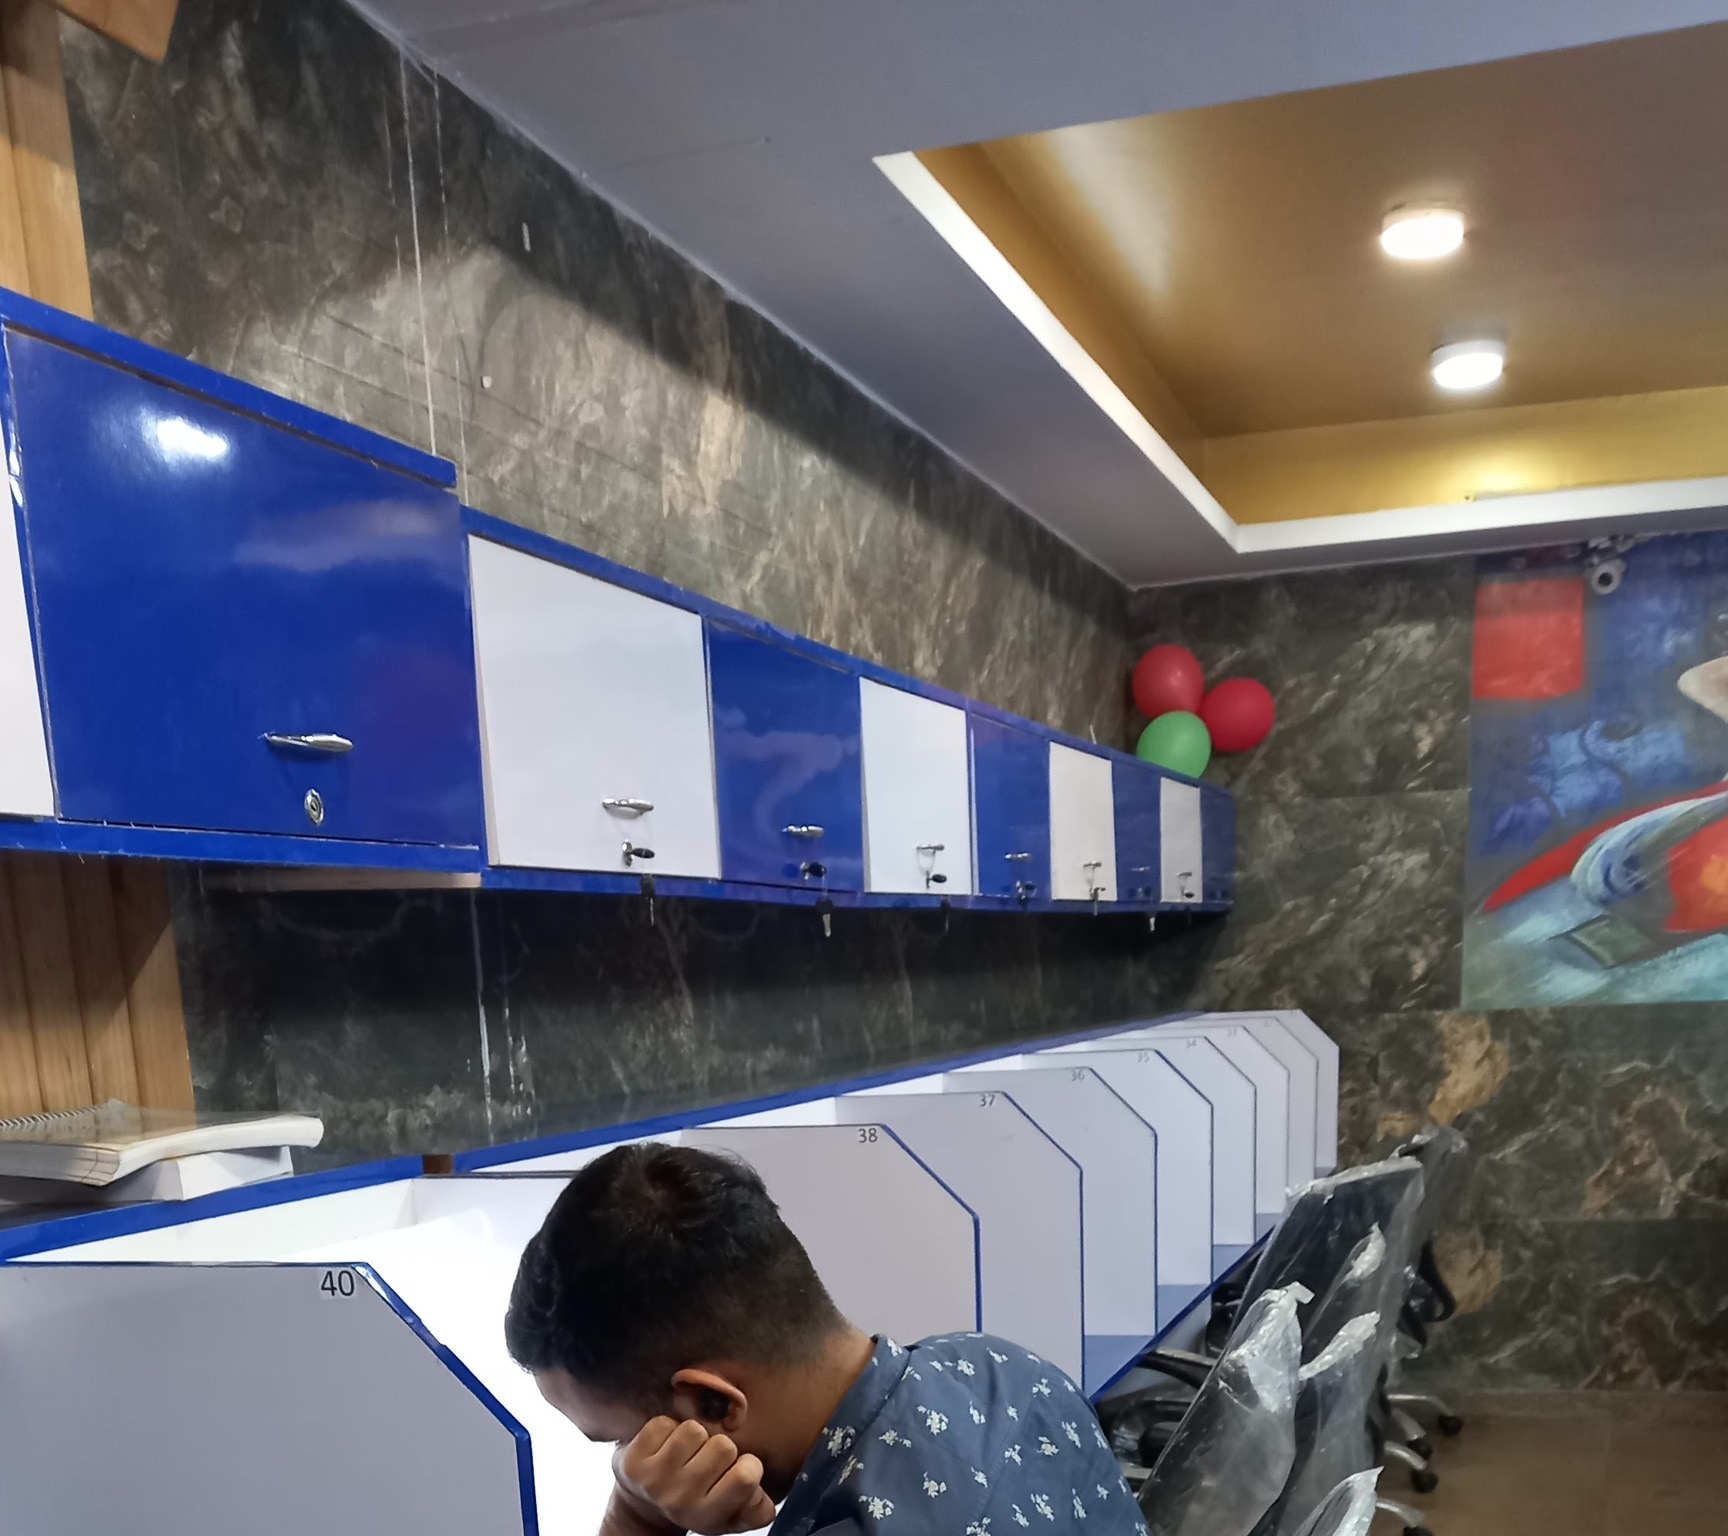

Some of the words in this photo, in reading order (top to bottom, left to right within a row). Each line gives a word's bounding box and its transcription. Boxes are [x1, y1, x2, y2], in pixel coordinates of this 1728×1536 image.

[1071, 1069, 1085, 1081] 36
[980, 1093, 995, 1107] 37
[858, 1127, 878, 1143] 38
[321, 1270, 355, 1297] 40
